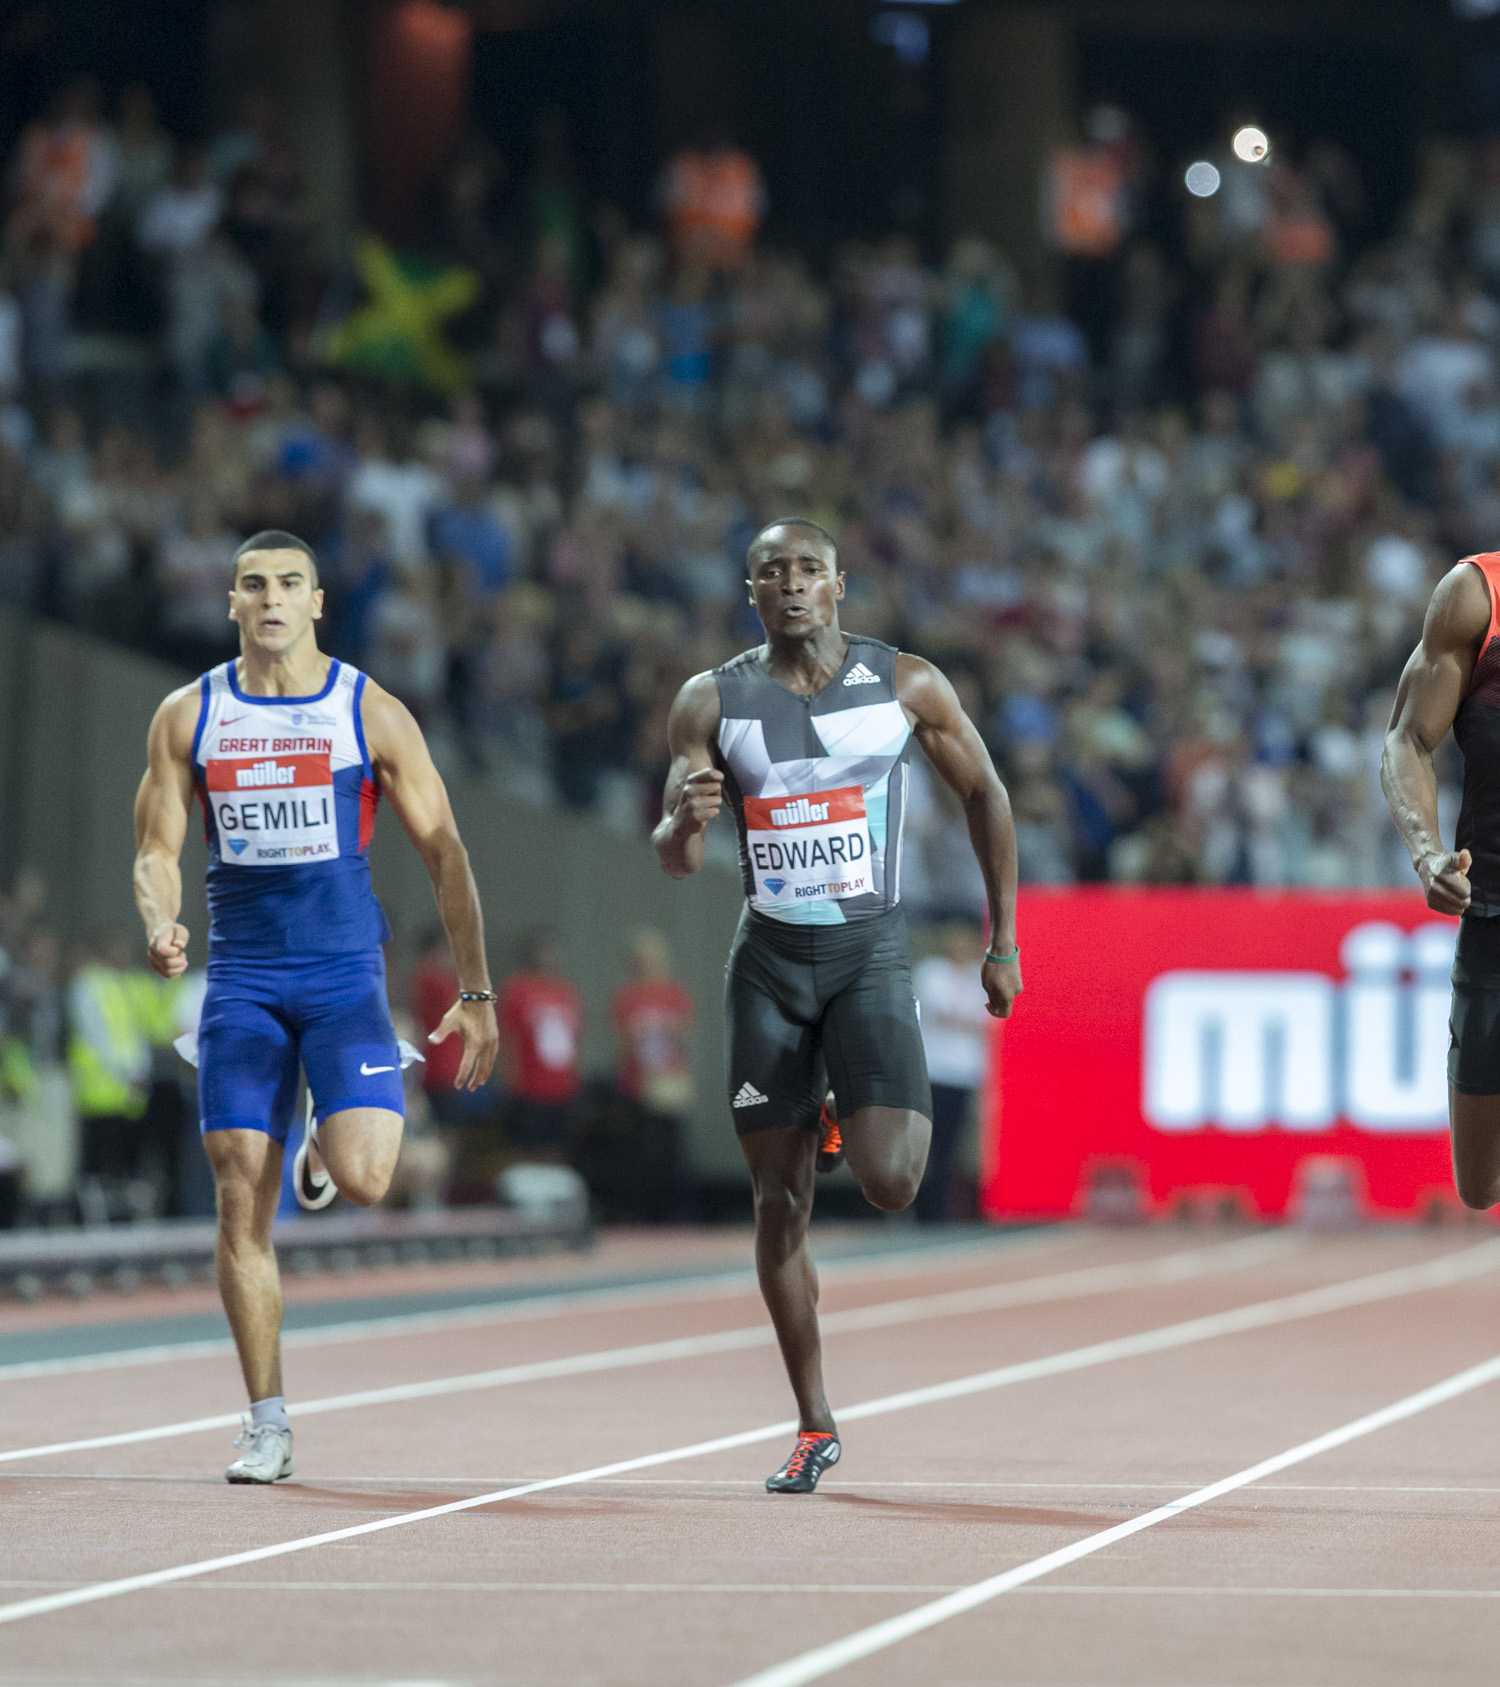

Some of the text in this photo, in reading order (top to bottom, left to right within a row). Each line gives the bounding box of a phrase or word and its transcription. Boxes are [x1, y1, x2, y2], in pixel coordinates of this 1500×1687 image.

[843, 674, 881, 687] adidas
[219, 737, 332, 753] GREAT BRITAIN
[235, 760, 296, 787] müller
[219, 798, 329, 831] GEMILI
[770, 799, 830, 826] müller
[751, 832, 864, 870] EDWARD
[733, 1094, 769, 1108] adidas
